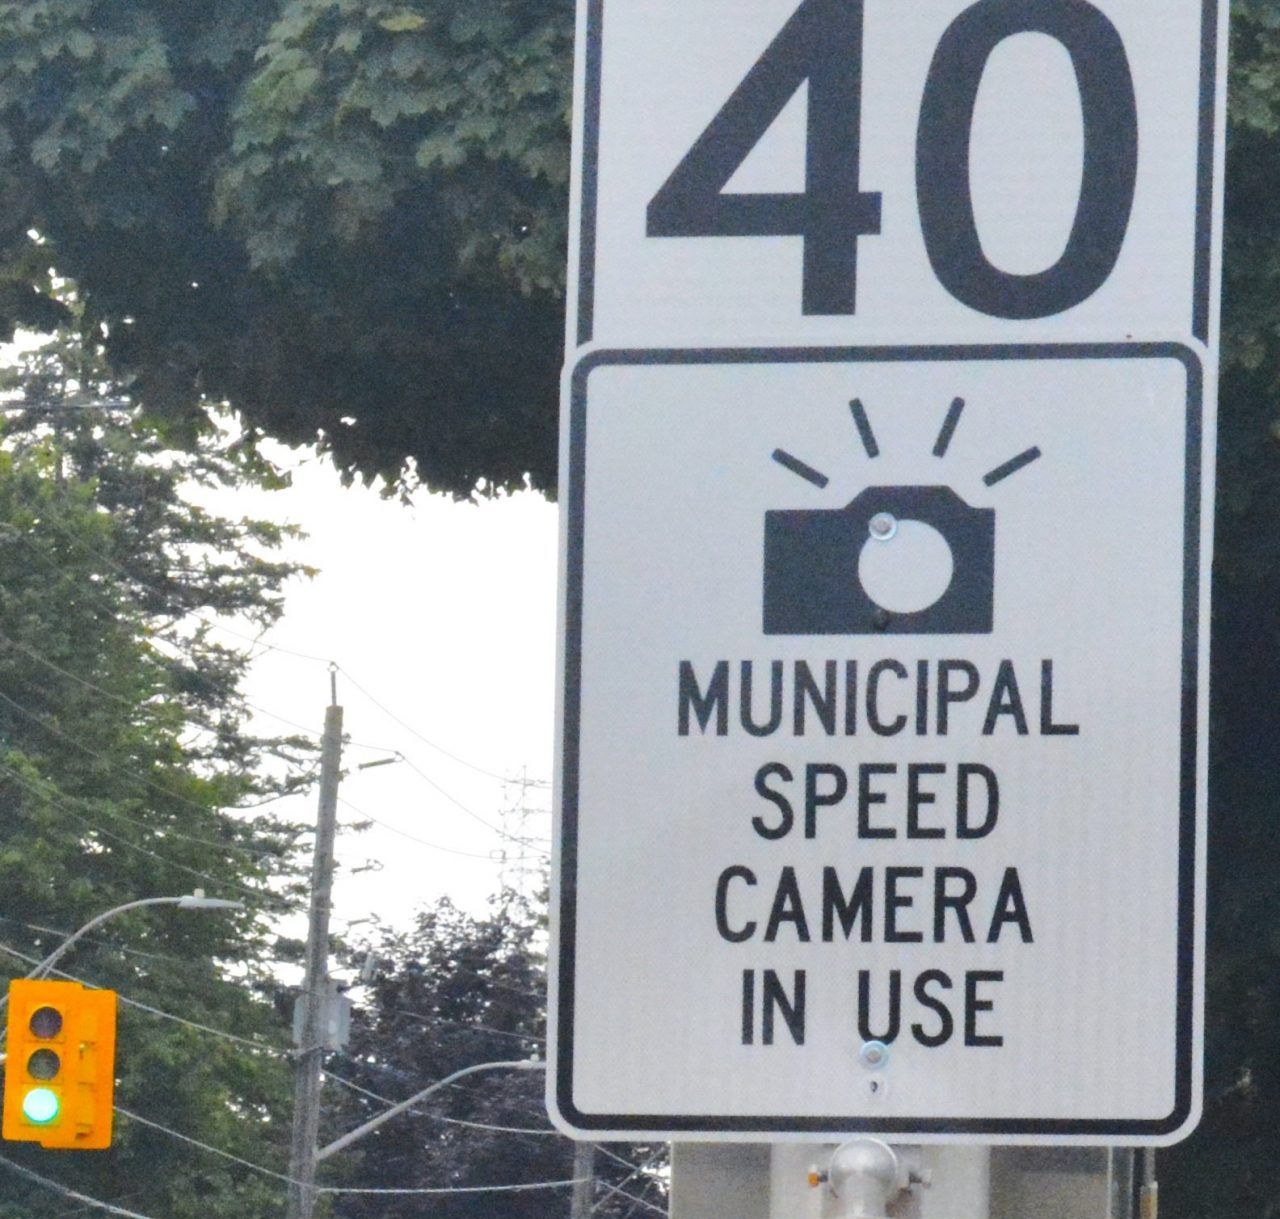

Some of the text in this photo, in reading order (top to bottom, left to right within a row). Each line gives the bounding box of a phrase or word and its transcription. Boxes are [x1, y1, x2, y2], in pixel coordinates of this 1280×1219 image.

[646, 0, 1140, 321] 40
[678, 658, 1081, 738] MUNICIPAL
[751, 762, 1000, 841] SPEED
[714, 864, 1035, 944] CAMERA
[741, 968, 1005, 1048] IN USE
